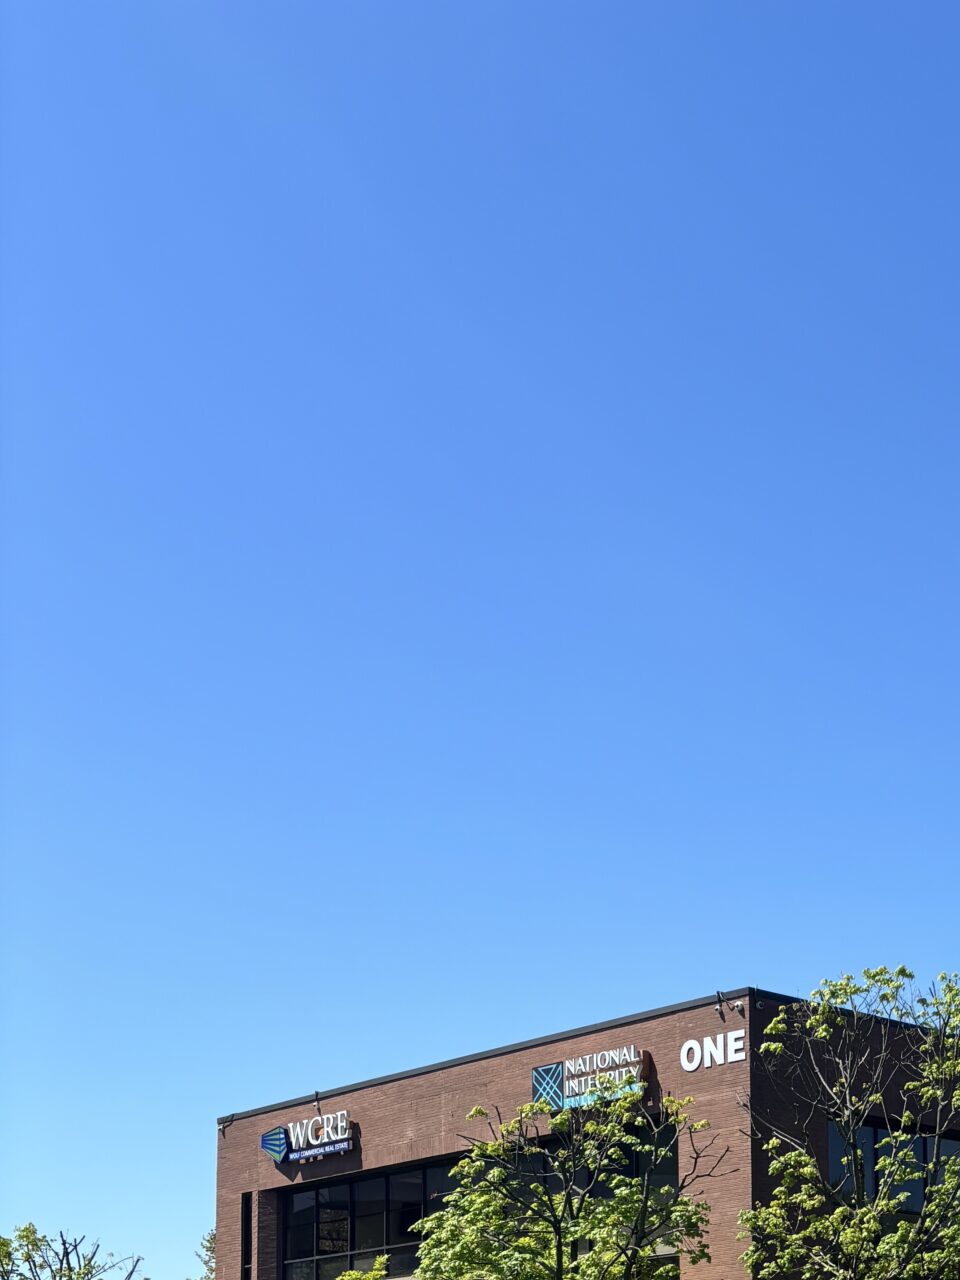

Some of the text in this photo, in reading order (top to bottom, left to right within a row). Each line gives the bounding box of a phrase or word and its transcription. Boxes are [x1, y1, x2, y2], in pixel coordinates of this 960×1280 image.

[565, 1045, 640, 1076] NATIONAL
[680, 1029, 746, 1073] ONE
[288, 1110, 349, 1150] WCRE
[300, 1146, 325, 1158] COMMERCIAL
[325, 1144, 334, 1154] REAL
[334, 1141, 349, 1151] ESTATE
